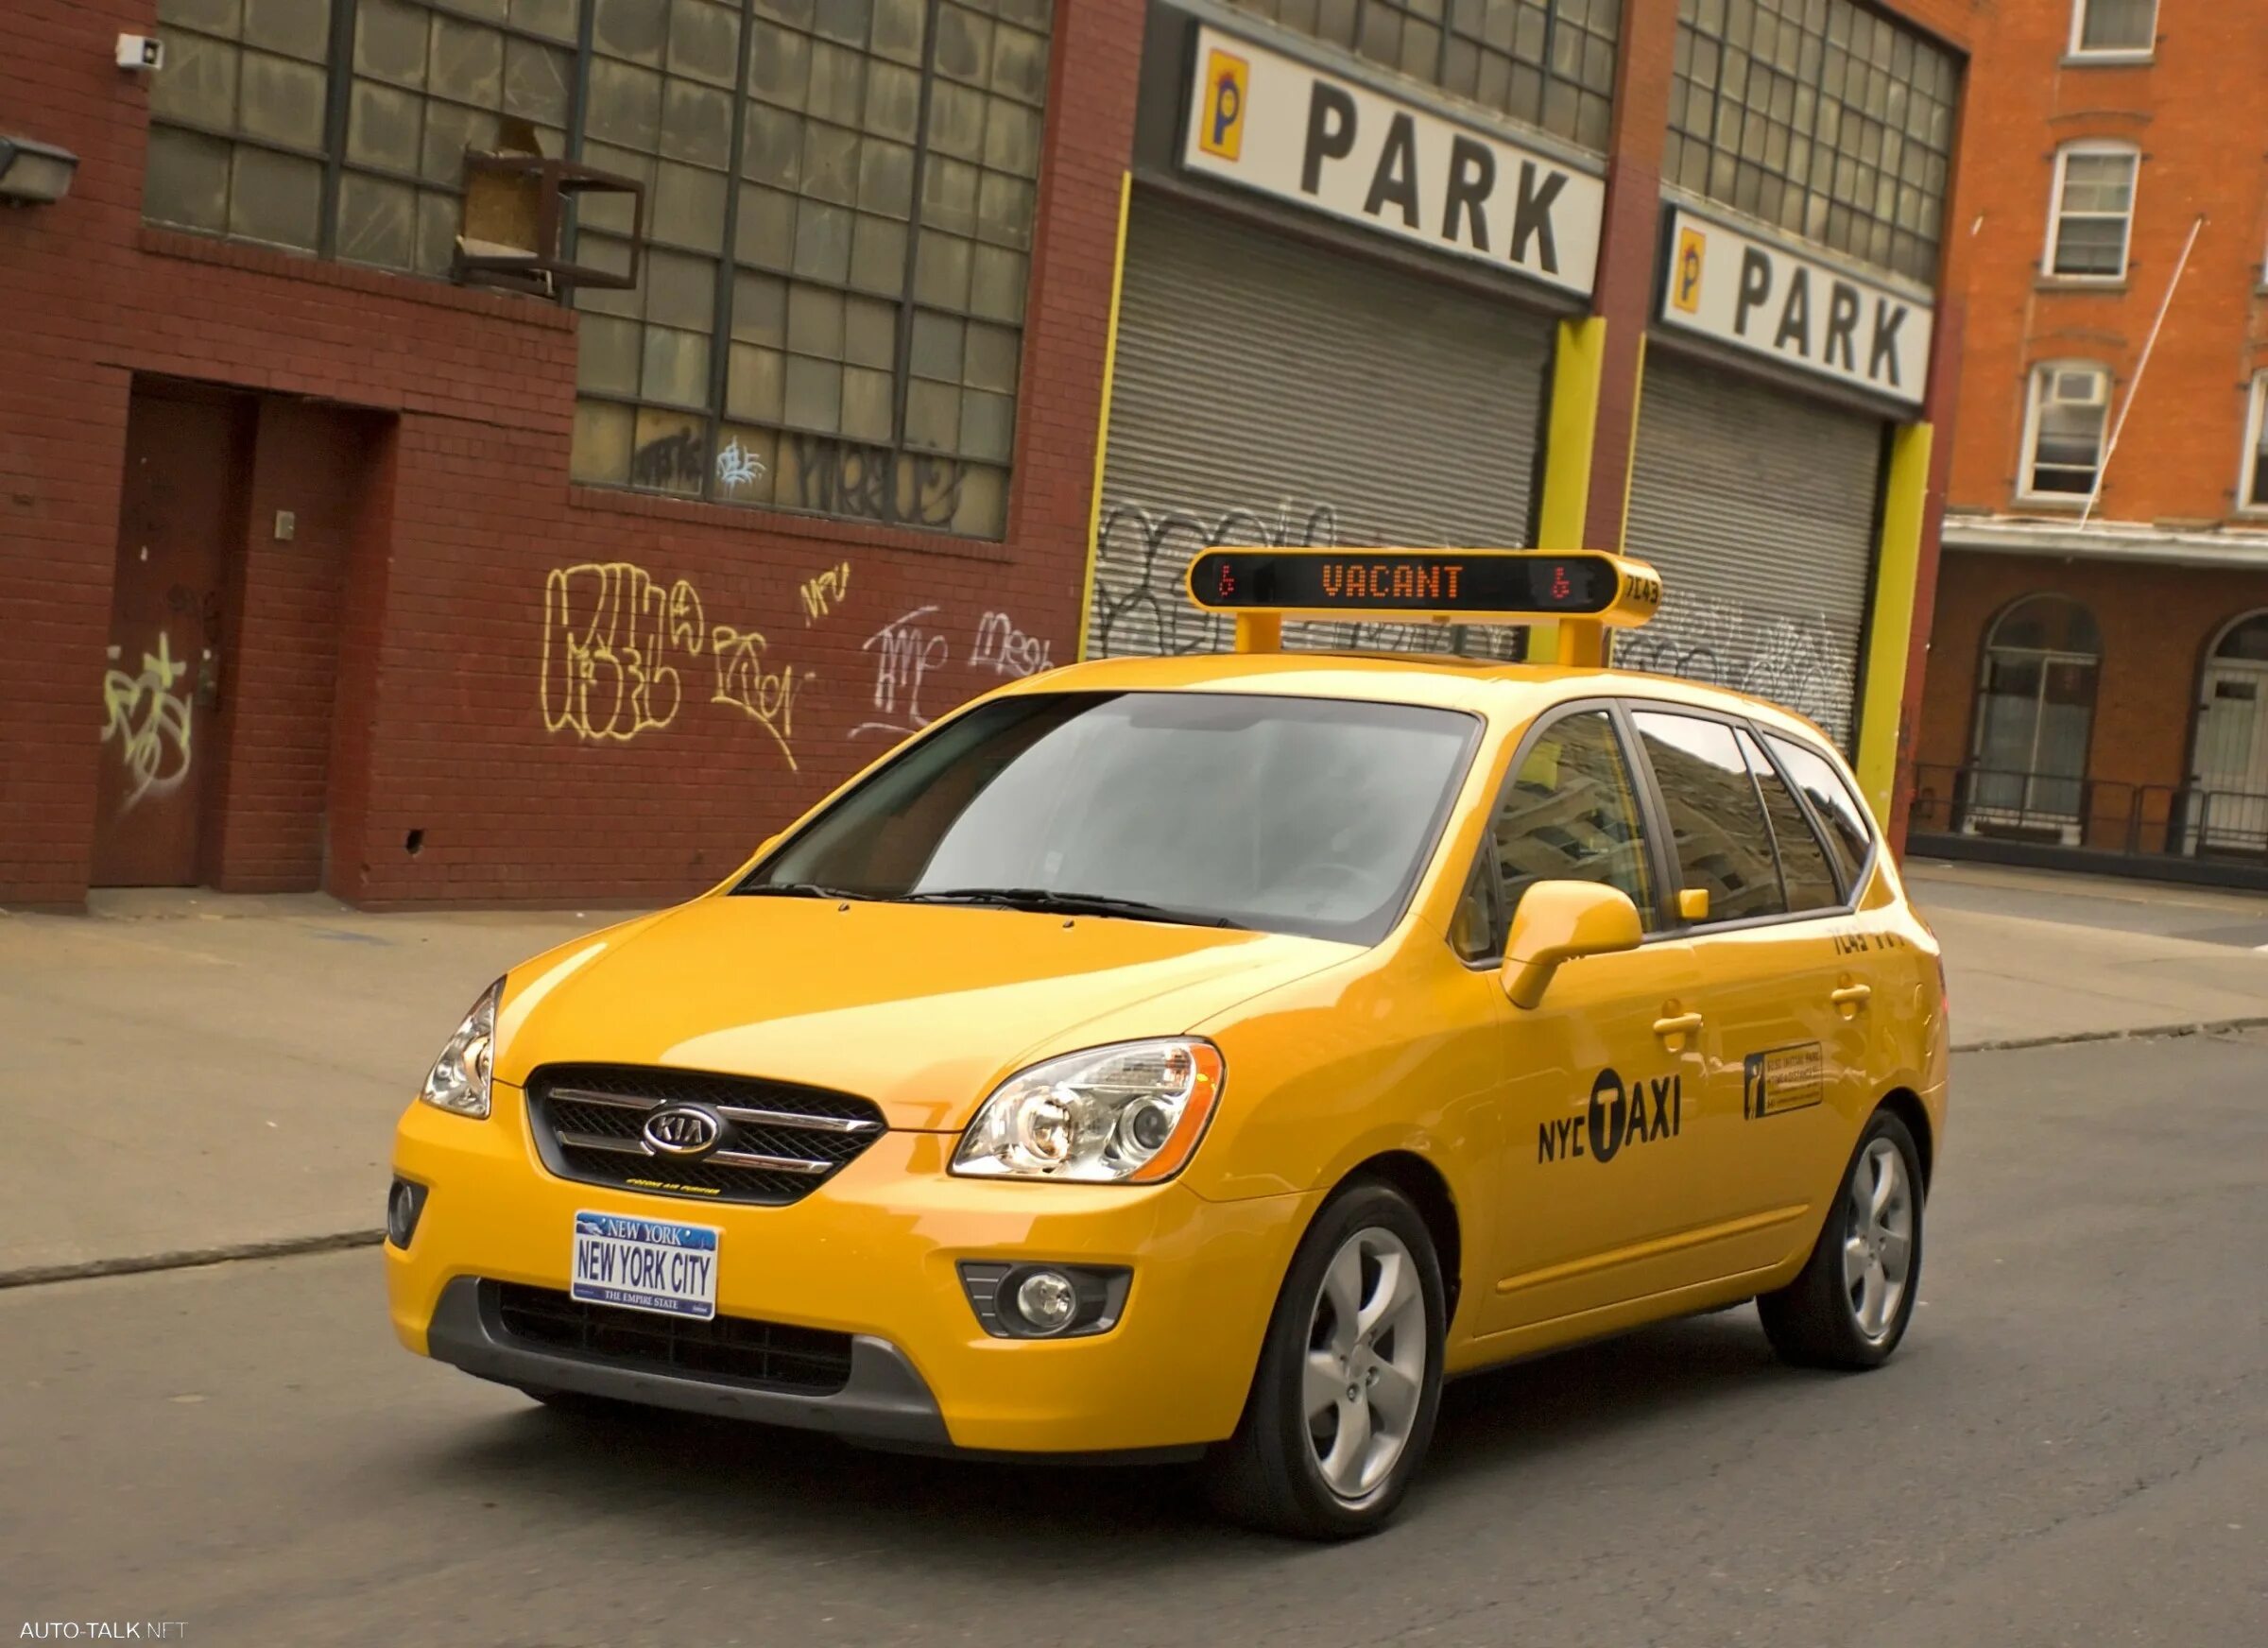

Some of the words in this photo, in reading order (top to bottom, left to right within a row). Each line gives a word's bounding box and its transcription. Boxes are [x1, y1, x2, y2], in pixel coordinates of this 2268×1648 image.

[1300, 77, 1569, 275] PARK
[1733, 244, 1907, 388] PARK
[1322, 564, 1464, 599] VACANT
[656, 1116, 703, 1143] KIA
[1591, 1071, 1682, 1158] TAXI
[608, 1219, 641, 1240] NEW
[643, 1225, 682, 1246] YORK
[577, 1239, 616, 1283] NEW
[620, 1245, 668, 1291] YORK
[671, 1251, 711, 1296] CITY
[605, 1290, 621, 1301] THE
[623, 1294, 653, 1306] EMPIRE
[654, 1297, 679, 1311] STATE
